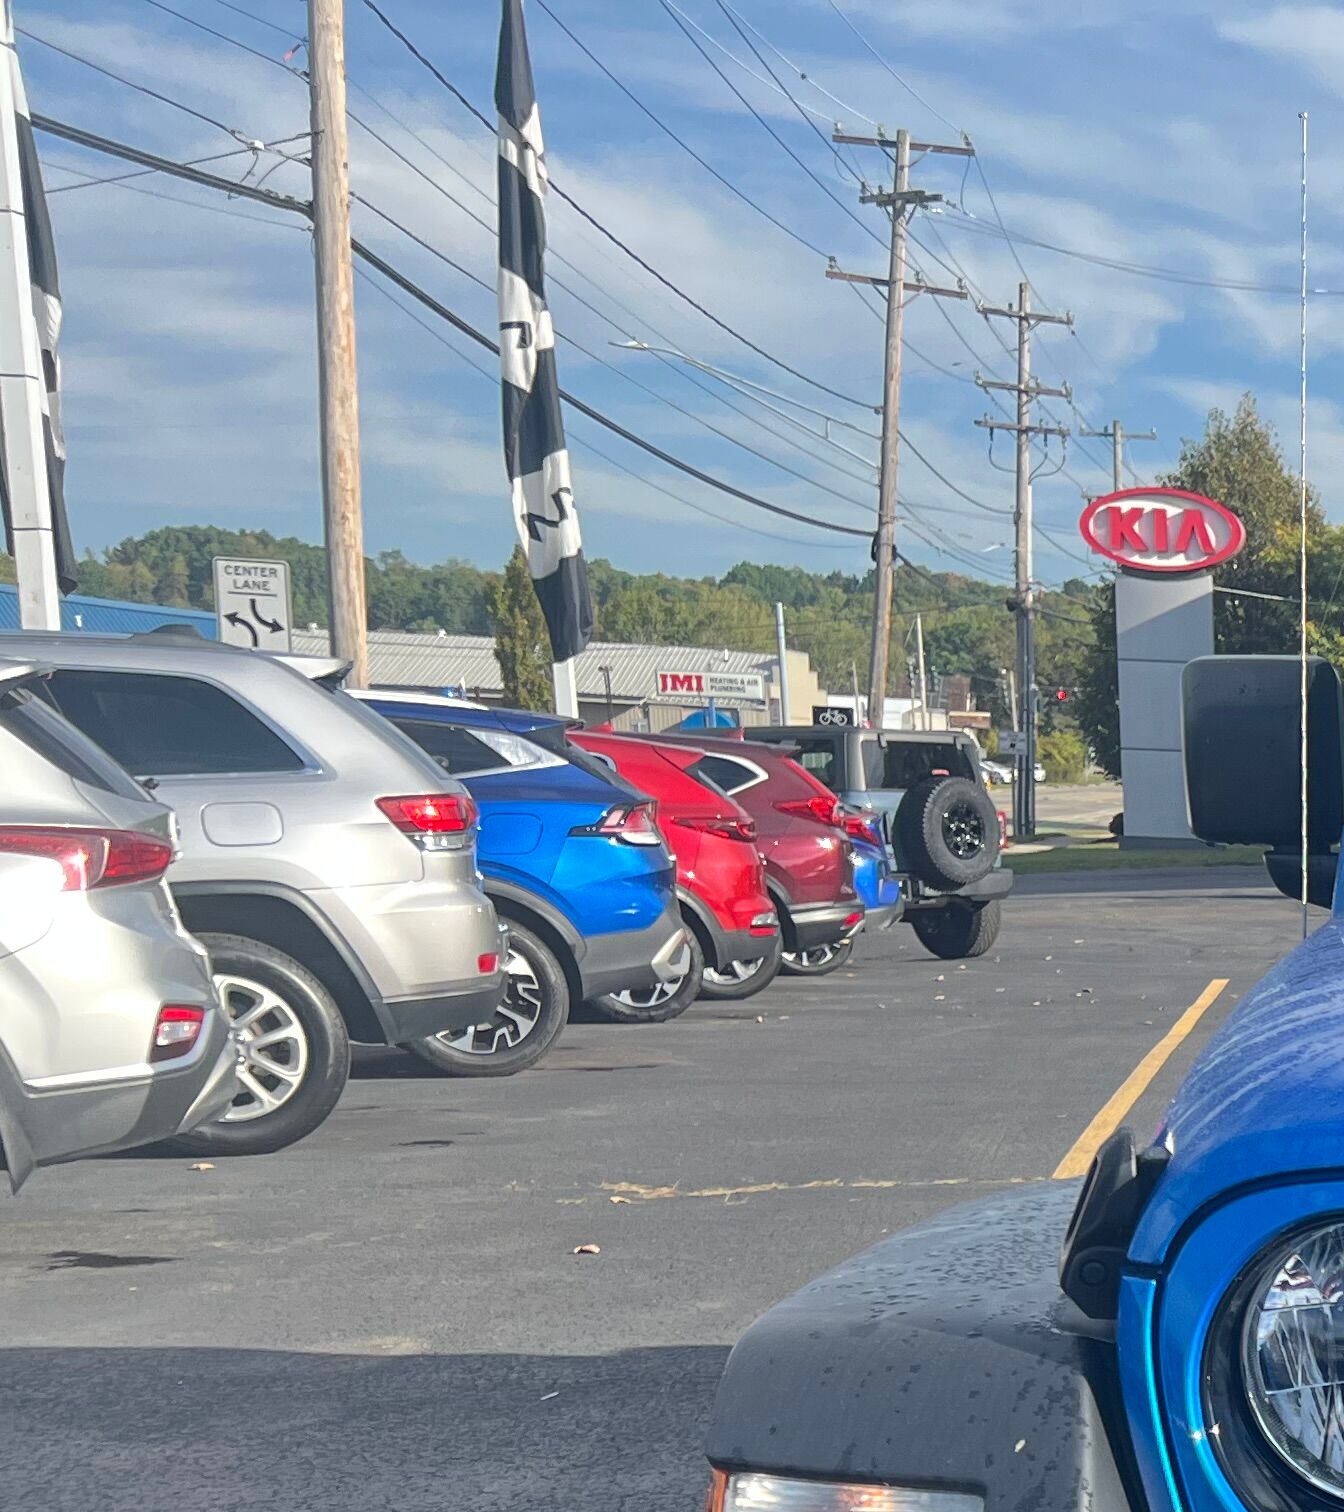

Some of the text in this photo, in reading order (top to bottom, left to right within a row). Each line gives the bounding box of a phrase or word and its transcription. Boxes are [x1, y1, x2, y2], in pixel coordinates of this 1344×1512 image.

[1107, 507, 1216, 554] KIA
[224, 565, 278, 578] CENTER
[233, 579, 271, 591] LANE
[659, 674, 703, 692] JMI
